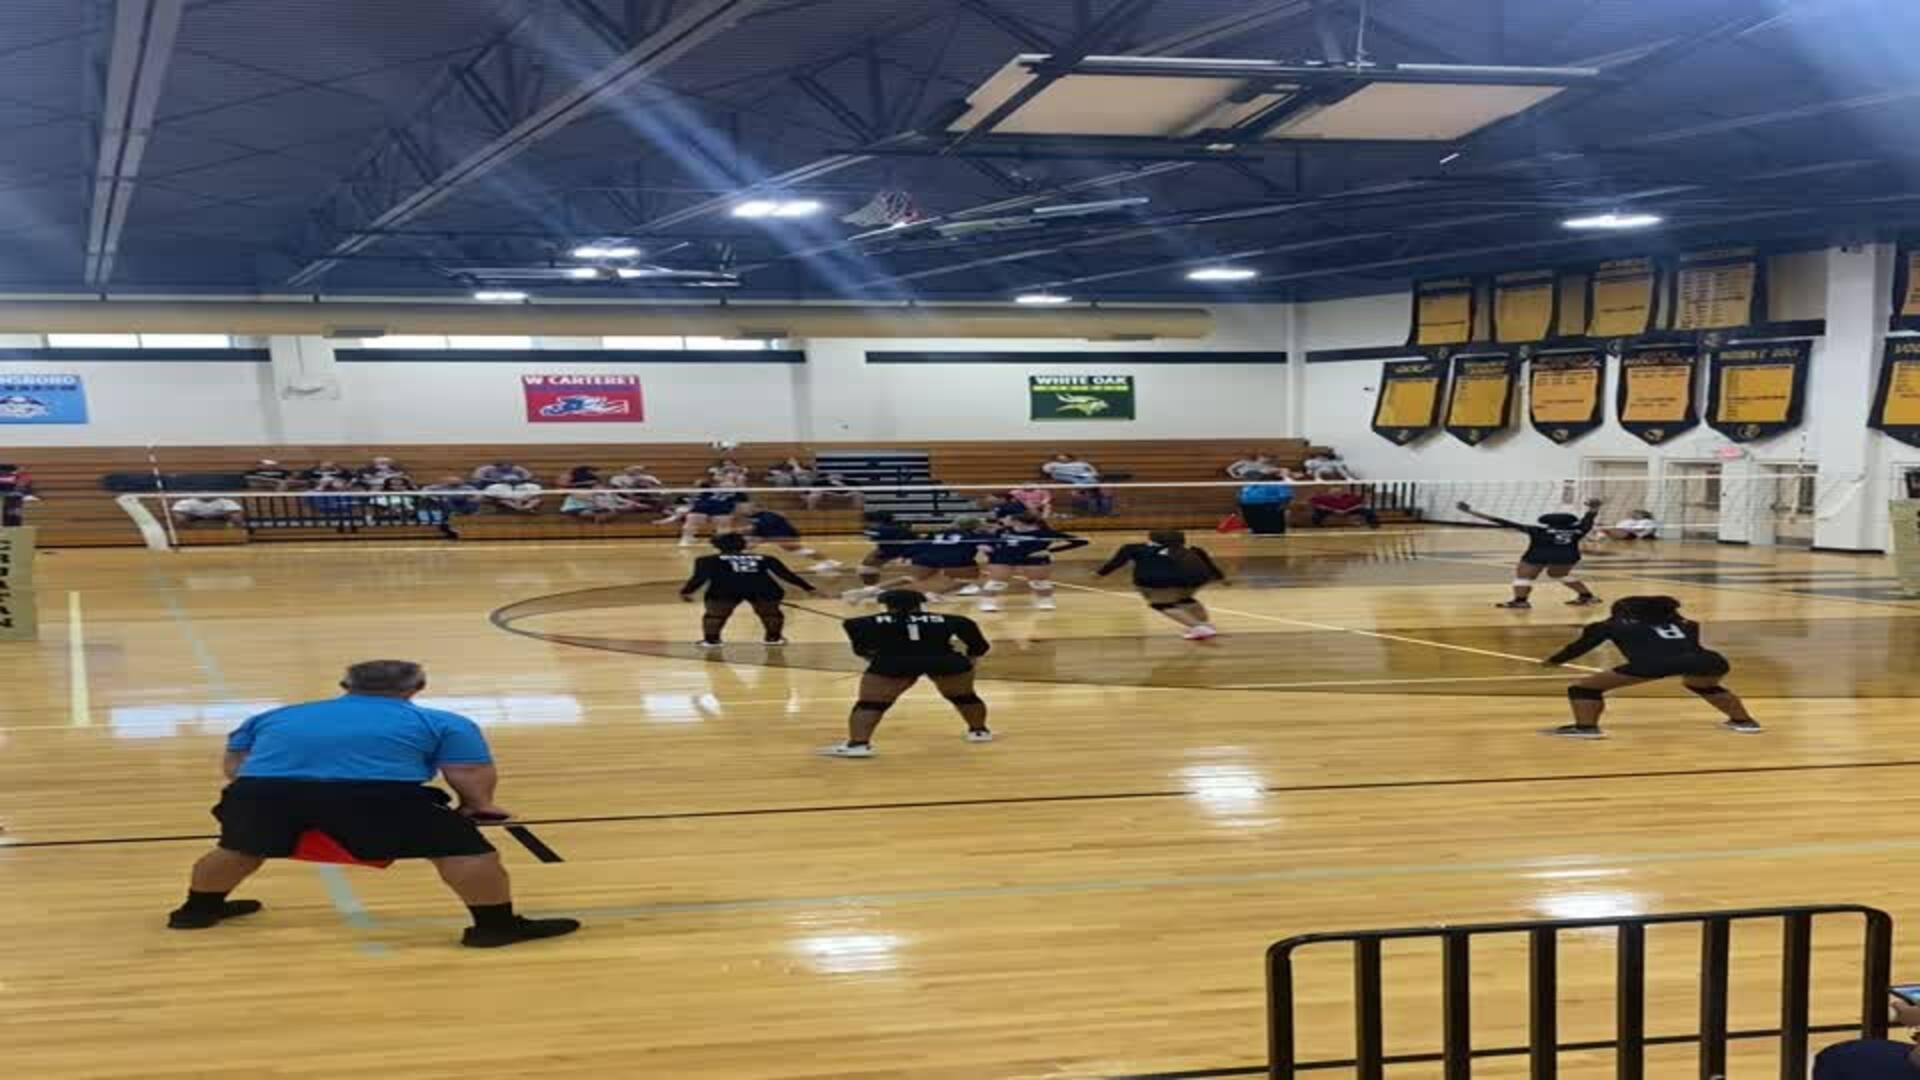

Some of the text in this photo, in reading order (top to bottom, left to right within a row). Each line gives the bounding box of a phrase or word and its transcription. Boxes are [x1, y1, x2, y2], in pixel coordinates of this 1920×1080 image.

[524, 375, 636, 385] W CARTERET
[1035, 376, 1127, 385] WHITE OAK
[729, 560, 758, 573] 12
[906, 623, 920, 641] 1
